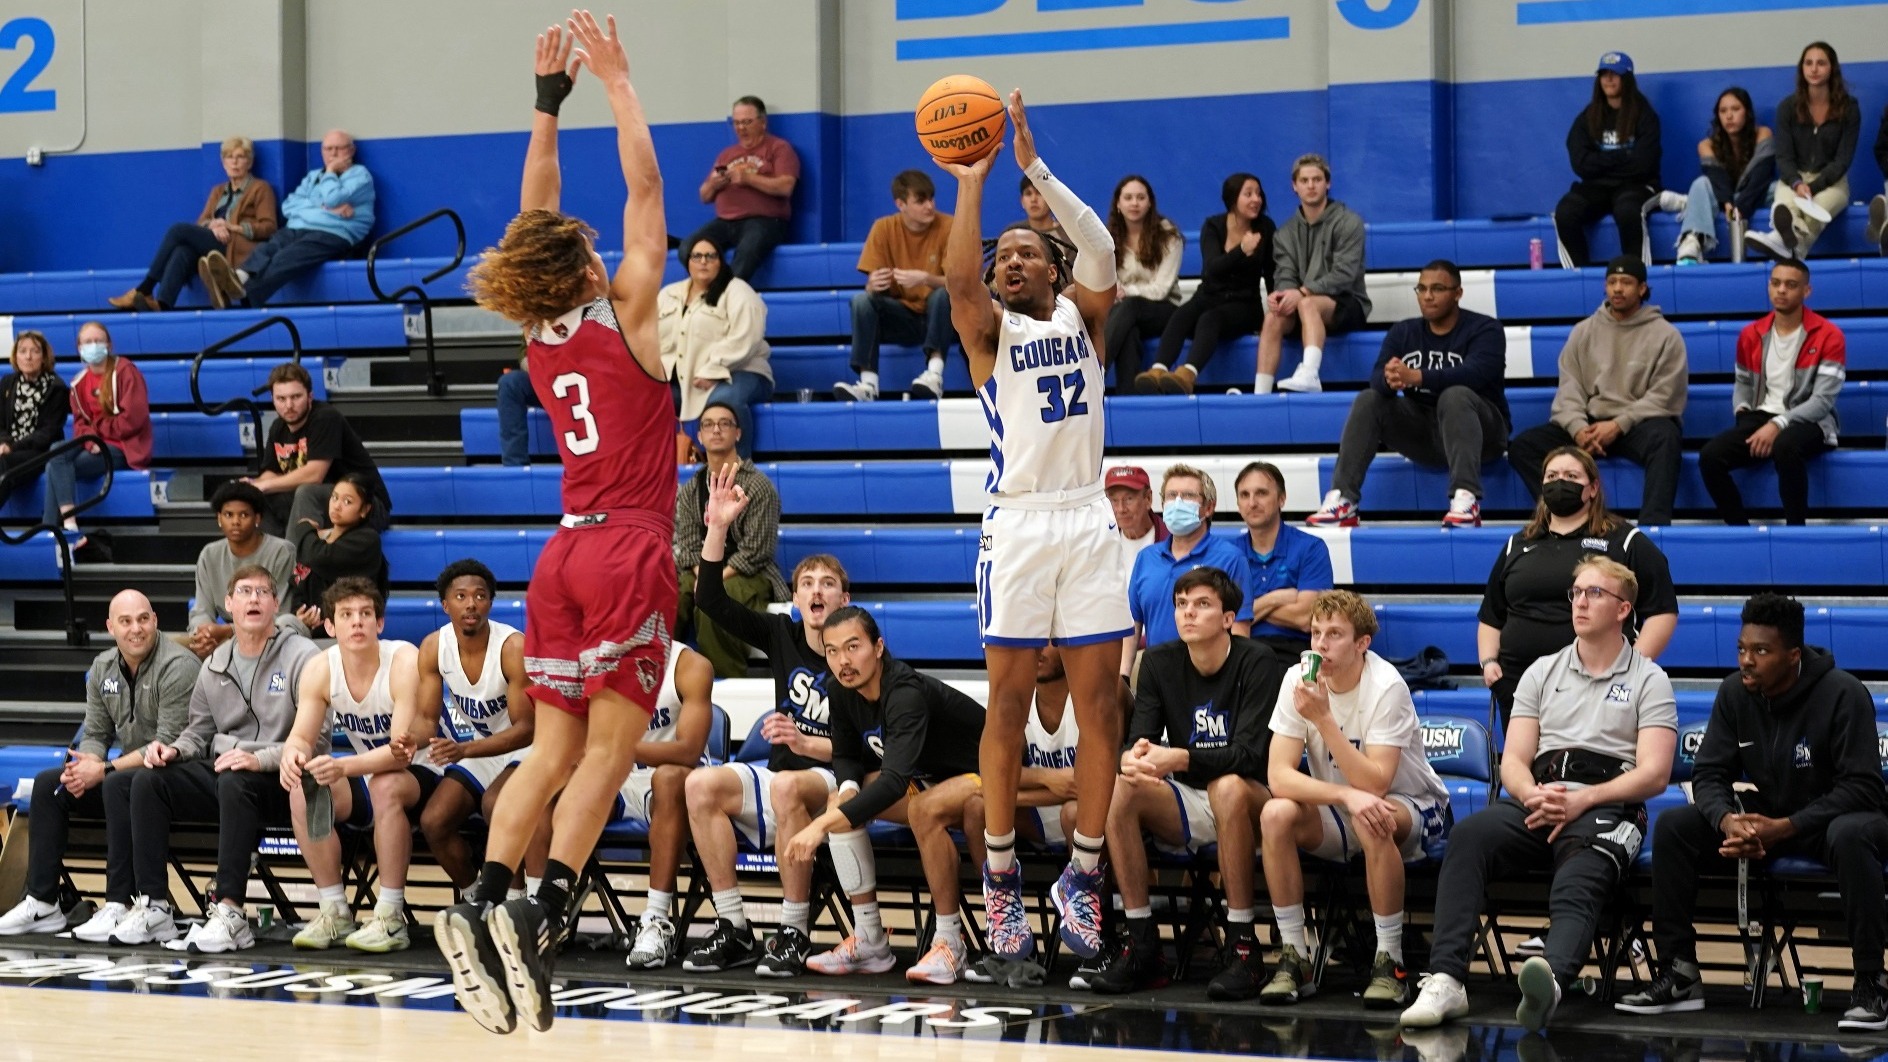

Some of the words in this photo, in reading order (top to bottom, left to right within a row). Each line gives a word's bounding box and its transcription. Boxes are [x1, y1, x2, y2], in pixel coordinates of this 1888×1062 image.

[0, 17, 56, 114] 2
[929, 126, 991, 151] Wilson
[1037, 369, 1089, 423] 32
[552, 372, 599, 456] 3
[103, 678, 118, 693] SM
[271, 673, 286, 691] SM
[1610, 684, 1630, 702] SM
[788, 672, 830, 725] SM
[1195, 708, 1228, 739] SM
